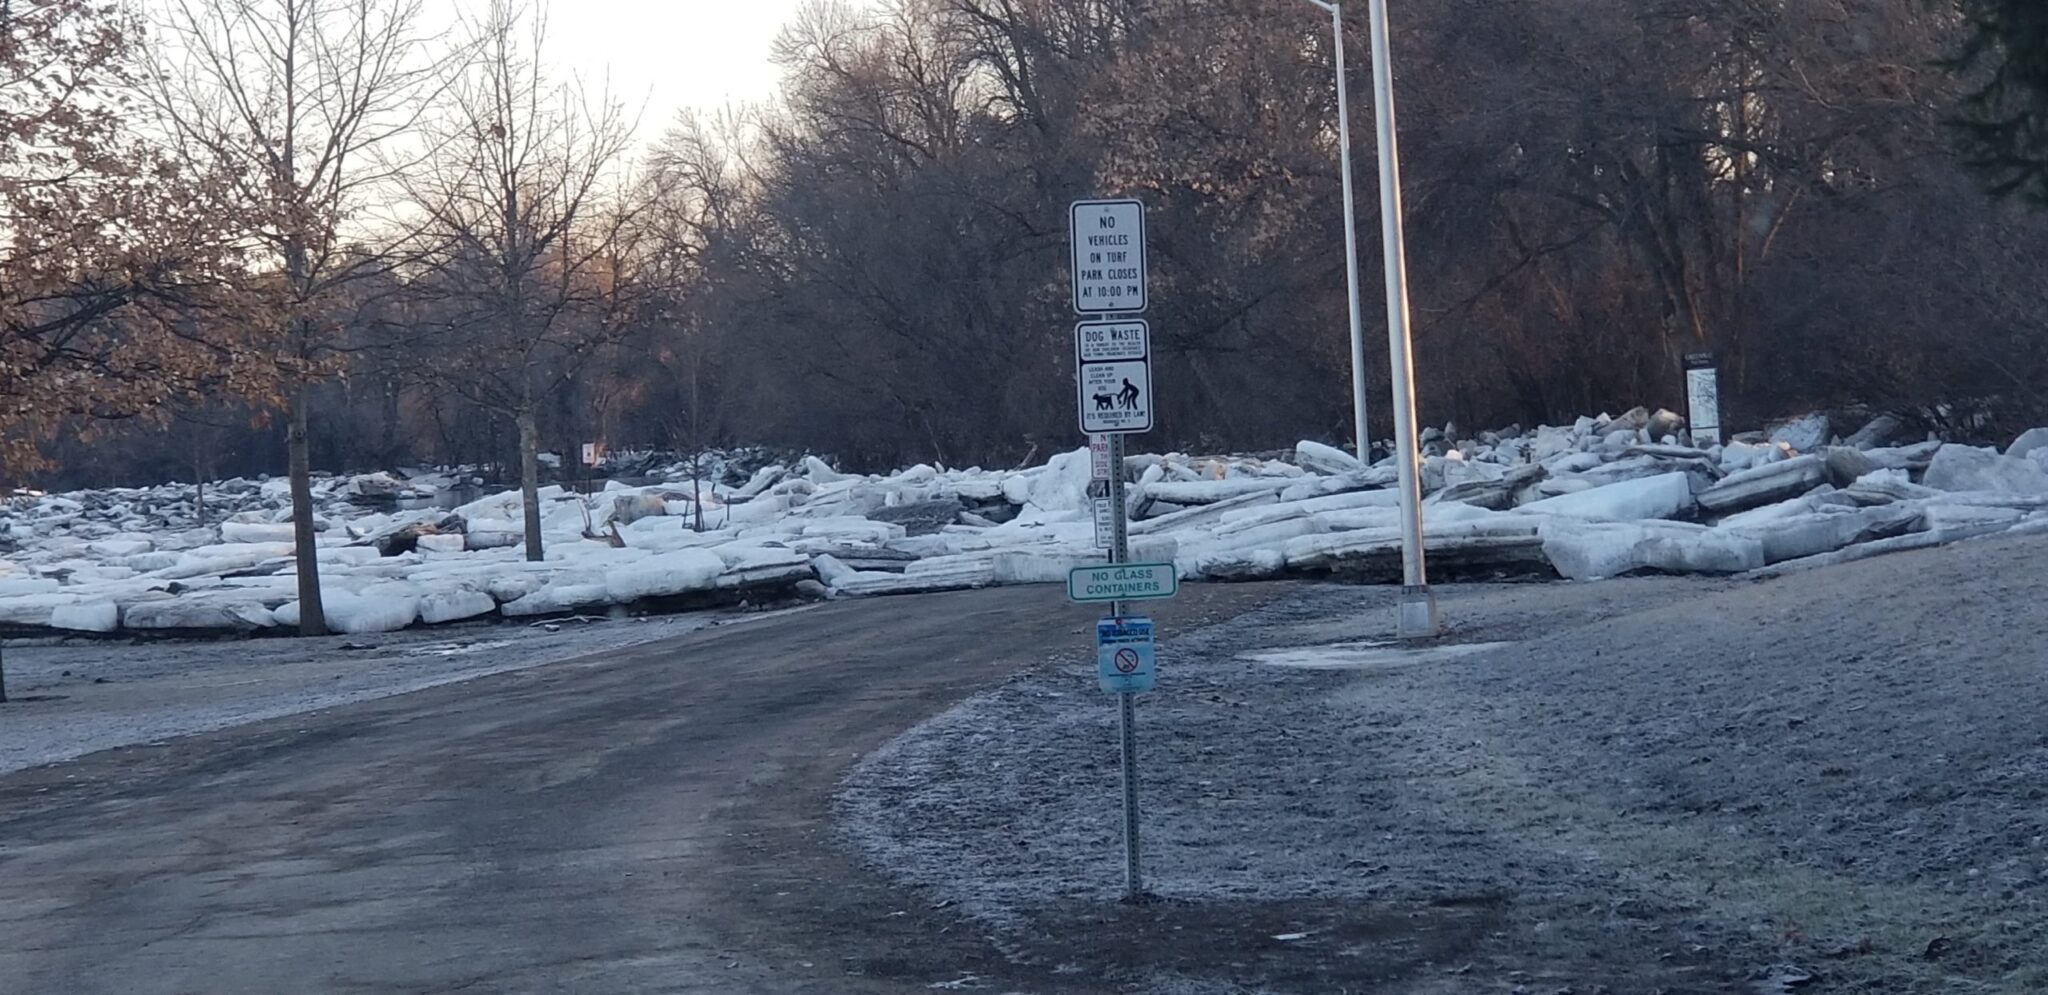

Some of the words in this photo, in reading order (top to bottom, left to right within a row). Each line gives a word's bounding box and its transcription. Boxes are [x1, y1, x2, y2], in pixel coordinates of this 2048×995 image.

[1100, 216, 1115, 229] NO
[1088, 235, 1128, 246] VEHICLES
[1090, 252, 1100, 264] ON
[1107, 252, 1127, 263] TURF
[1082, 270, 1102, 280] PARK
[1108, 268, 1138, 280] CLOSES
[1082, 286, 1092, 298] AT
[1098, 286, 1121, 297] 10:00
[1127, 286, 1138, 296] PM
[1085, 331, 1104, 342] DOG
[1111, 329, 1140, 340] WASTE
[1092, 572, 1108, 582] NO
[1114, 570, 1152, 580] GLASS
[1086, 582, 1160, 594] CONTAINERS
